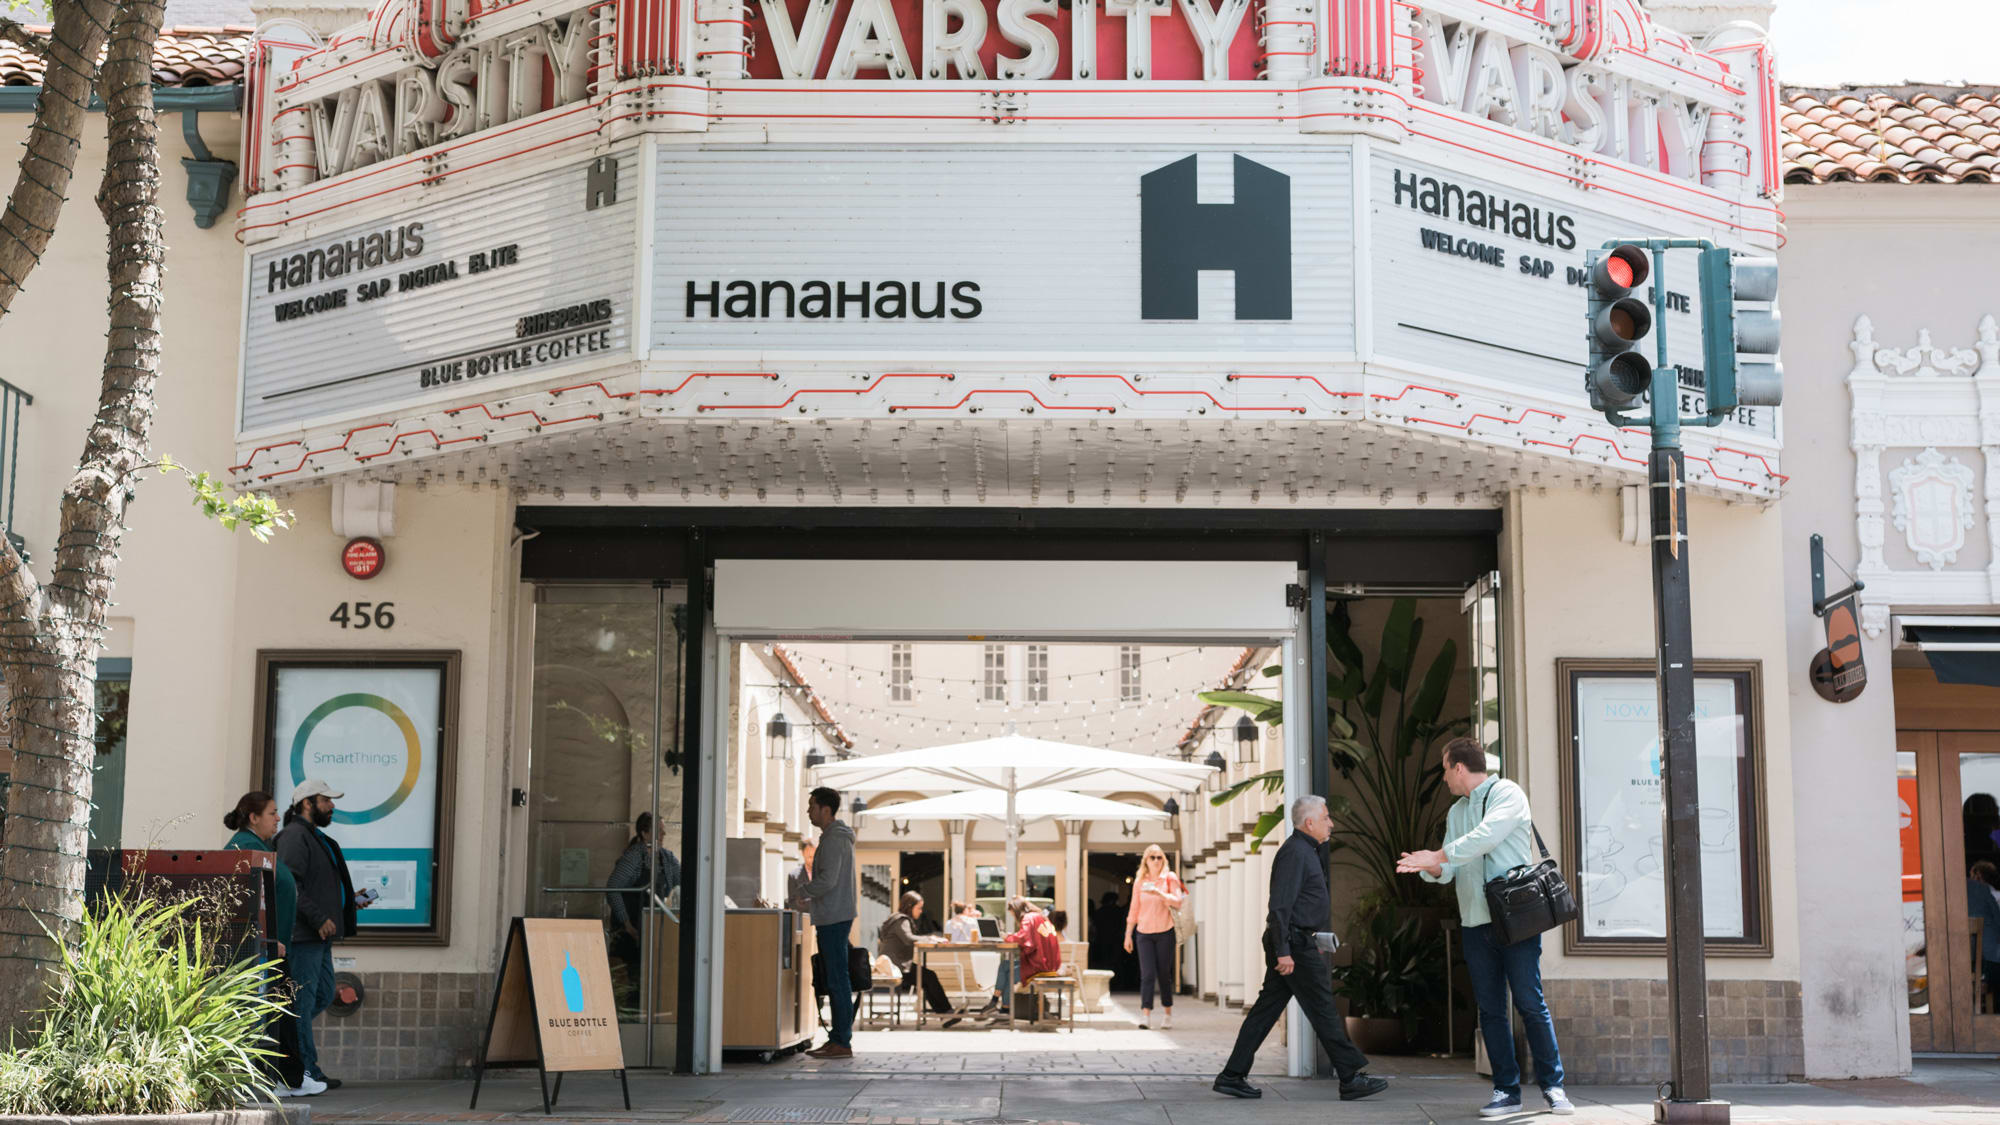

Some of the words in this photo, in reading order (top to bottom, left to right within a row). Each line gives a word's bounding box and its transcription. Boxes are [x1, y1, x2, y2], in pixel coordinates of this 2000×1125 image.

[762, 0, 1250, 80] VARSITY
[309, 11, 597, 180] VARSITY
[1424, 14, 1713, 184] VARSITY
[275, 288, 348, 322] WELCOME
[357, 278, 391, 302] SAP
[398, 260, 458, 292] DIGITAL
[468, 244, 518, 274] ELITE
[1420, 227, 1505, 268] WELCOME
[1519, 255, 1555, 279] SAP
[1648, 286, 1691, 314] EITE
[515, 299, 612, 338] #HHSPEAKS
[420, 361, 462, 388] BLUE
[466, 346, 531, 378] BOTTLE
[535, 329, 610, 362] COFFEE
[329, 602, 395, 629] 456
[1605, 703, 1651, 718] NOW
[313, 752, 399, 767] SmartThings
[549, 1018, 572, 1028] BLUE
[574, 1017, 608, 1027] BOTTLE
